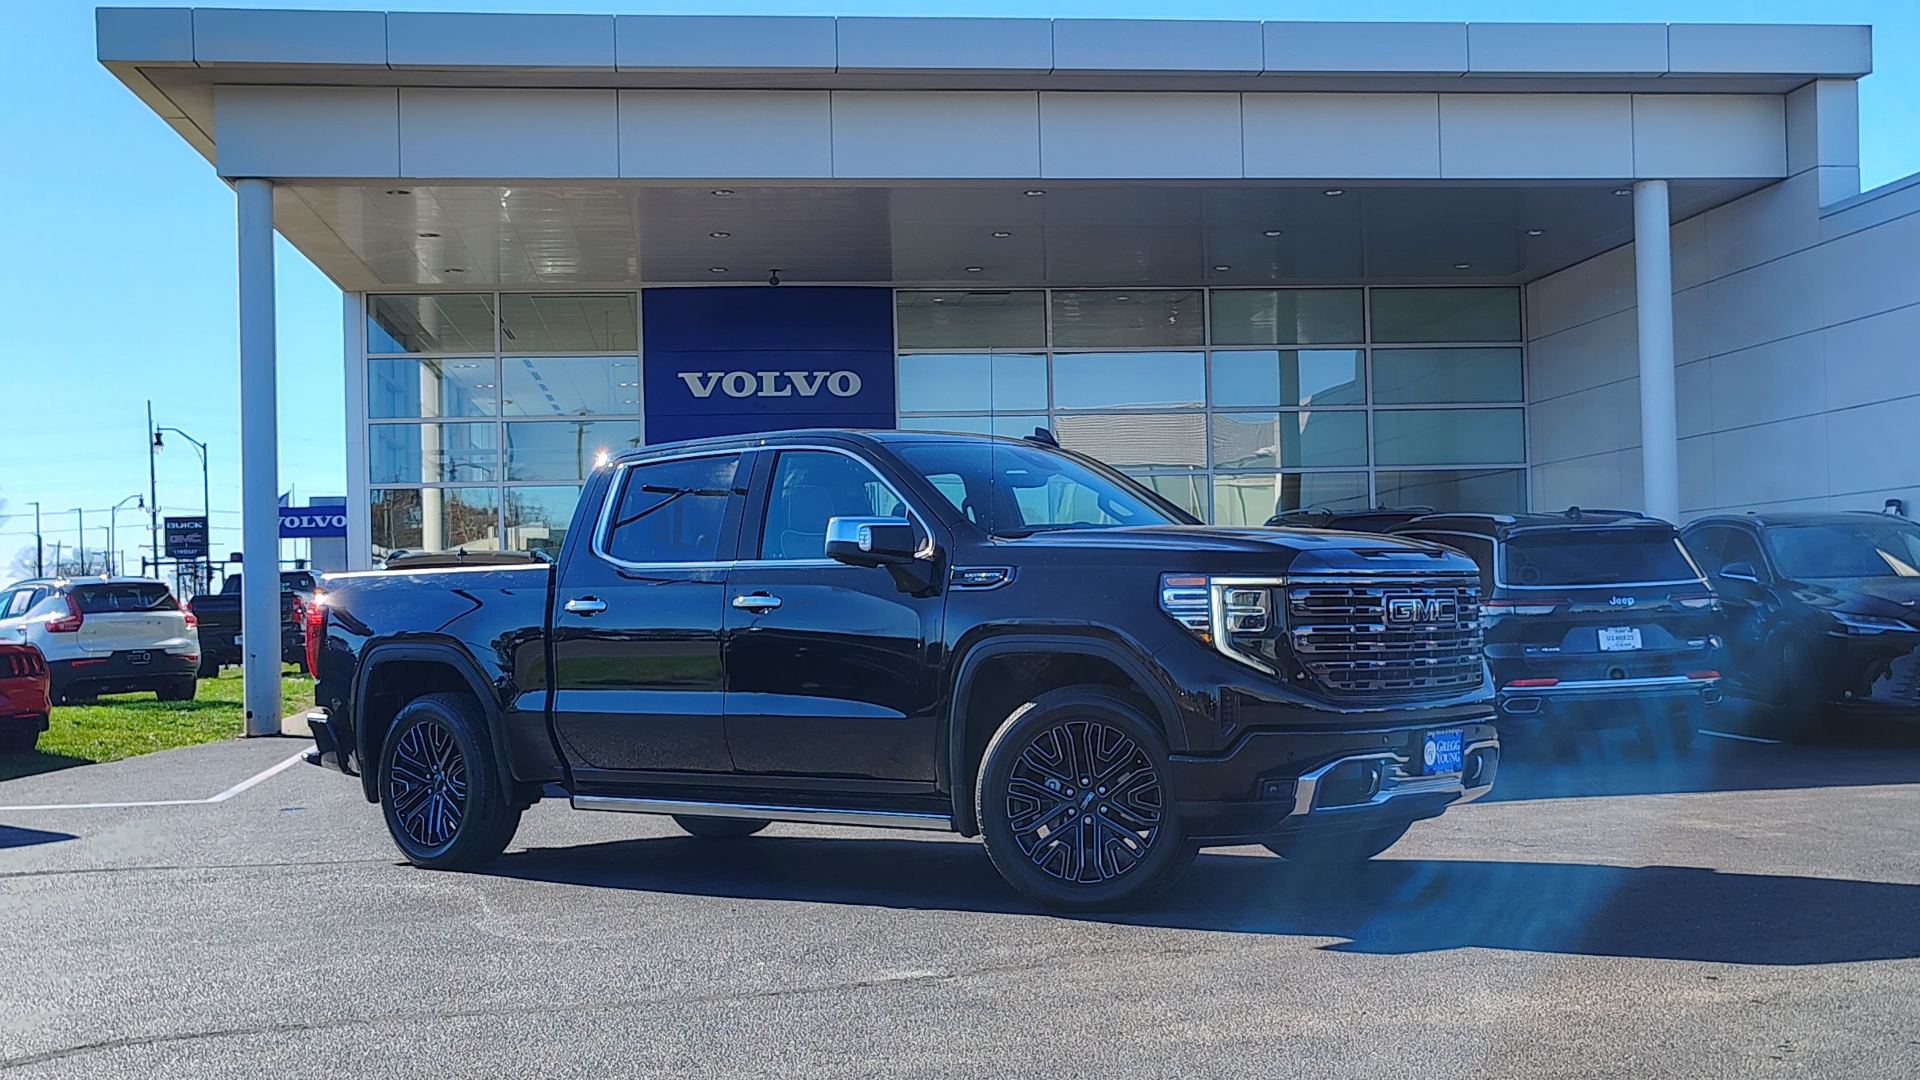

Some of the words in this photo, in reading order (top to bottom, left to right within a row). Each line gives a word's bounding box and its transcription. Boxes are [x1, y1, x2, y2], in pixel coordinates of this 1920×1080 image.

[678, 371, 862, 397] VOLVO
[167, 521, 203, 529] BUICK
[1609, 595, 1635, 606] Jeep
[1389, 599, 1455, 621] GMC
[1437, 740, 1460, 752] GREGG
[1437, 752, 1460, 764] YOUNG
